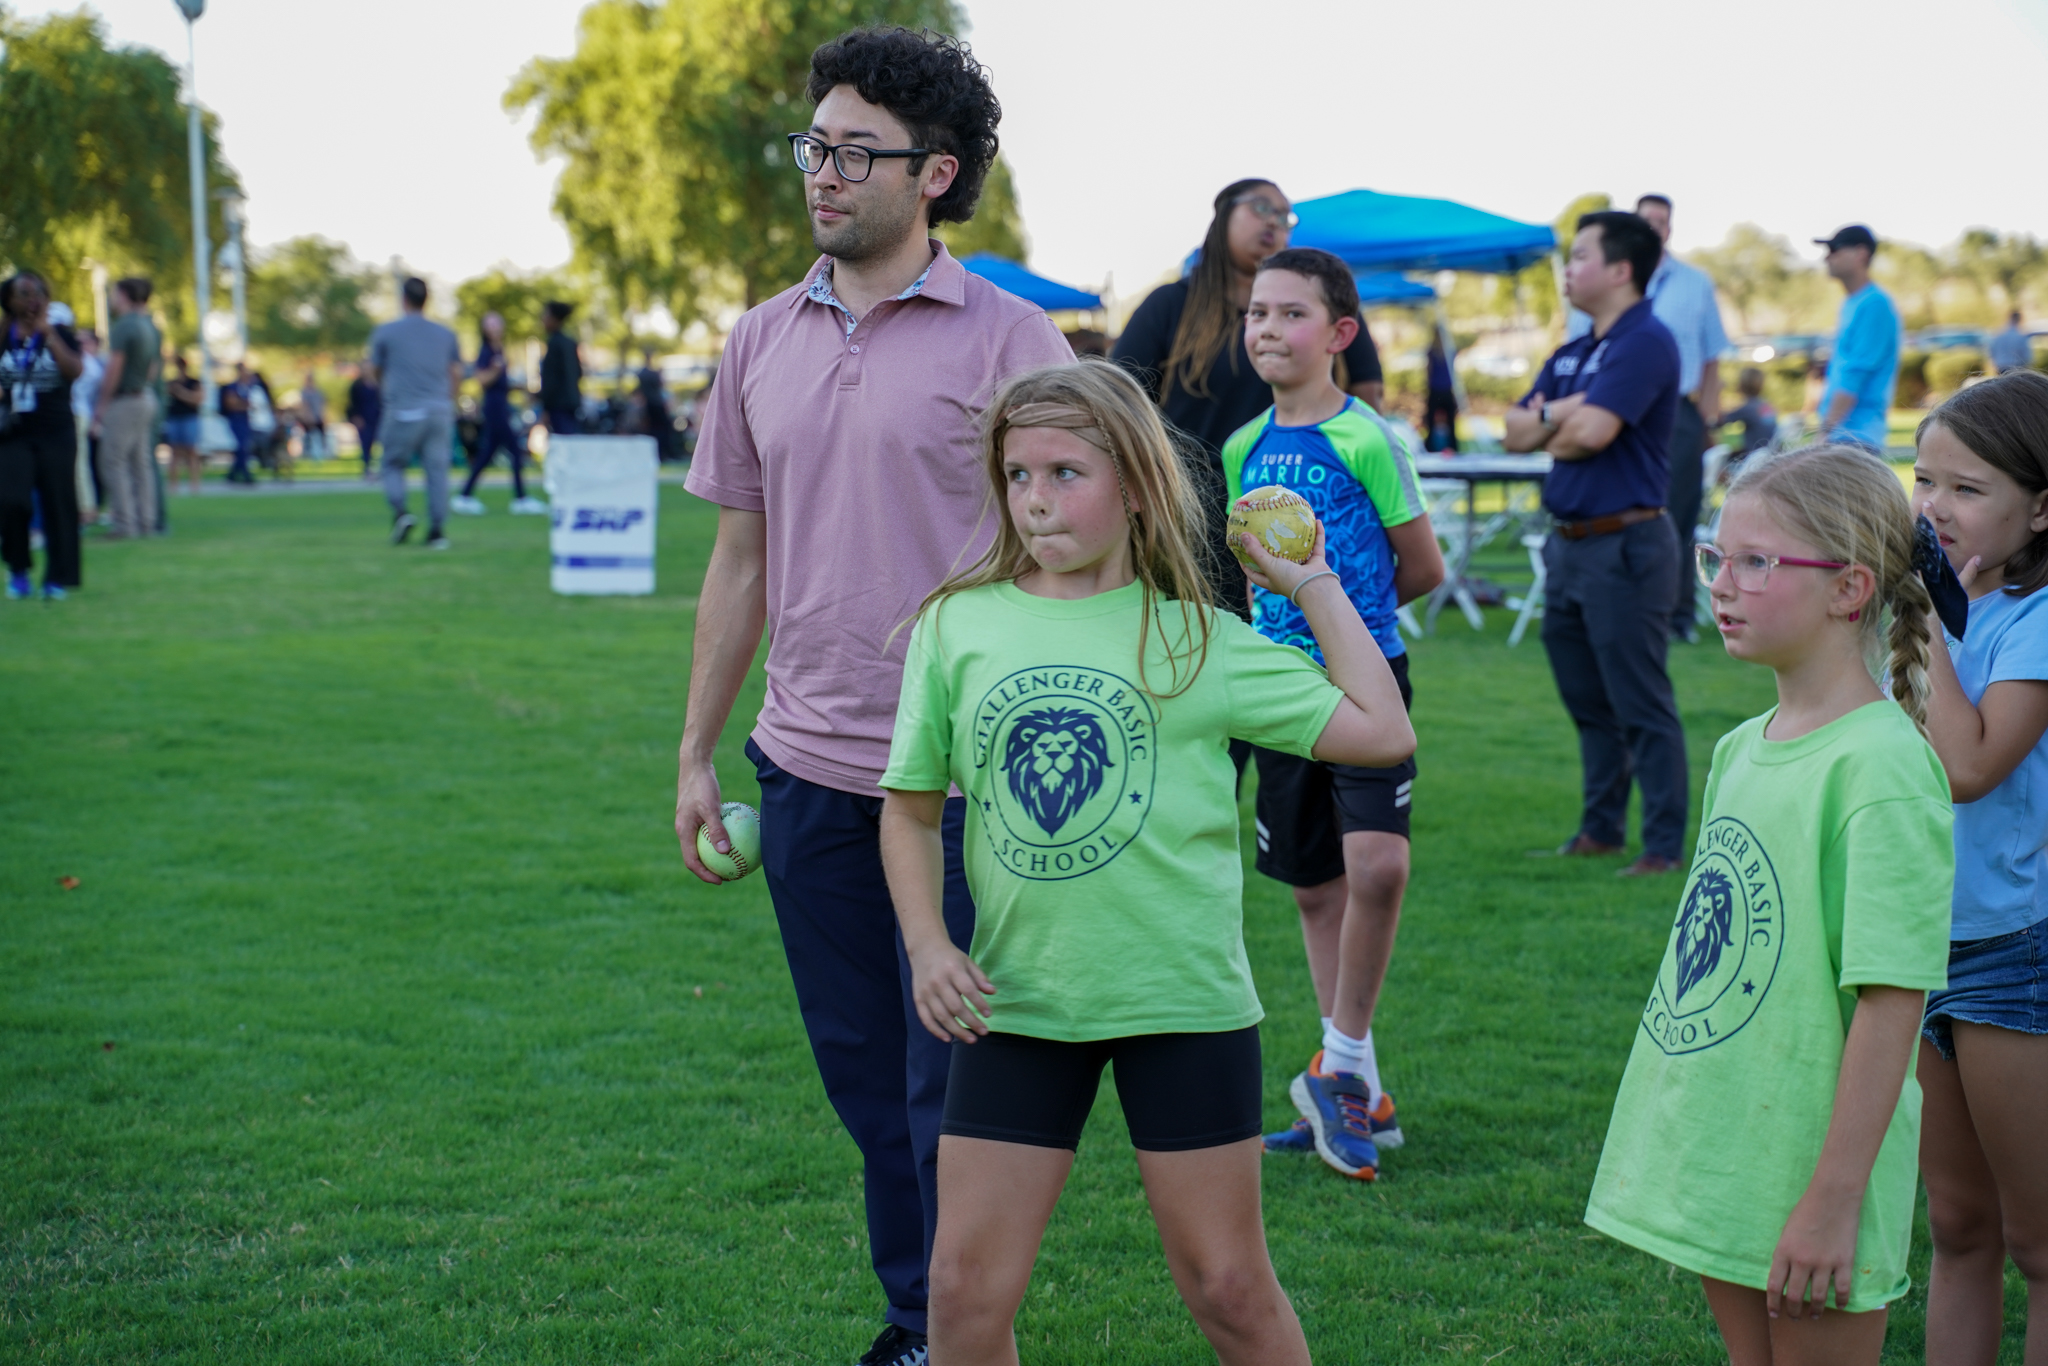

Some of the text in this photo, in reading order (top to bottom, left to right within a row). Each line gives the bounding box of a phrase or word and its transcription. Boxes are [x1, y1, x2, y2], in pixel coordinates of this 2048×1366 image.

[1244, 465, 1326, 485] MARIO
[1261, 453, 1304, 466] SUPER
[975, 672, 1147, 769] CHALLENGER BASIC
[1000, 834, 1118, 872] SCHOOL
[1696, 825, 1772, 948] LENGER BASIC
[1645, 996, 1718, 1047] SCHOOL
